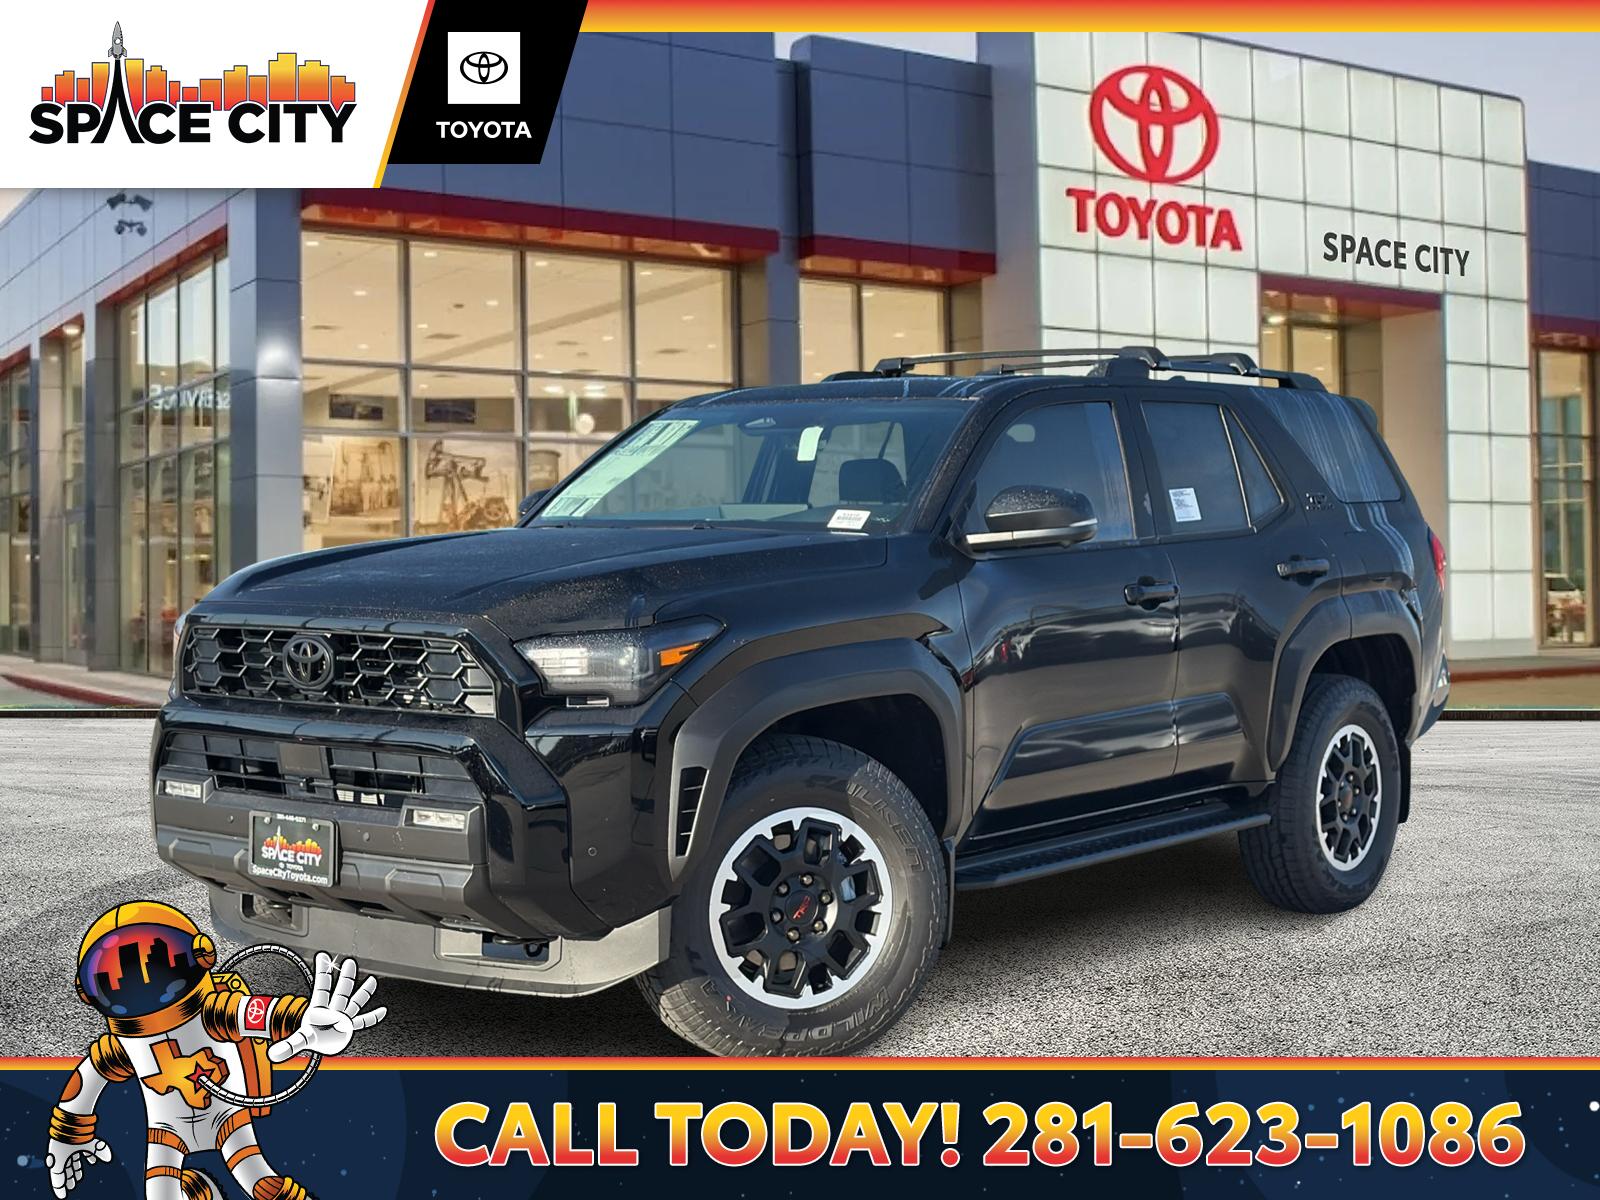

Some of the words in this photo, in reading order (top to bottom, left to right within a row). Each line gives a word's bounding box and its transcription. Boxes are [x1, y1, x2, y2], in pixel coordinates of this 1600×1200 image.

[1066, 187, 1242, 251] TOYOTA
[1323, 232, 1407, 270] SPACE
[1414, 244, 1470, 277] CITY
[286, 863, 304, 872] TOYOTA
[296, 852, 322, 867] CITY
[252, 865, 328, 884] SpaceCityToyota.com
